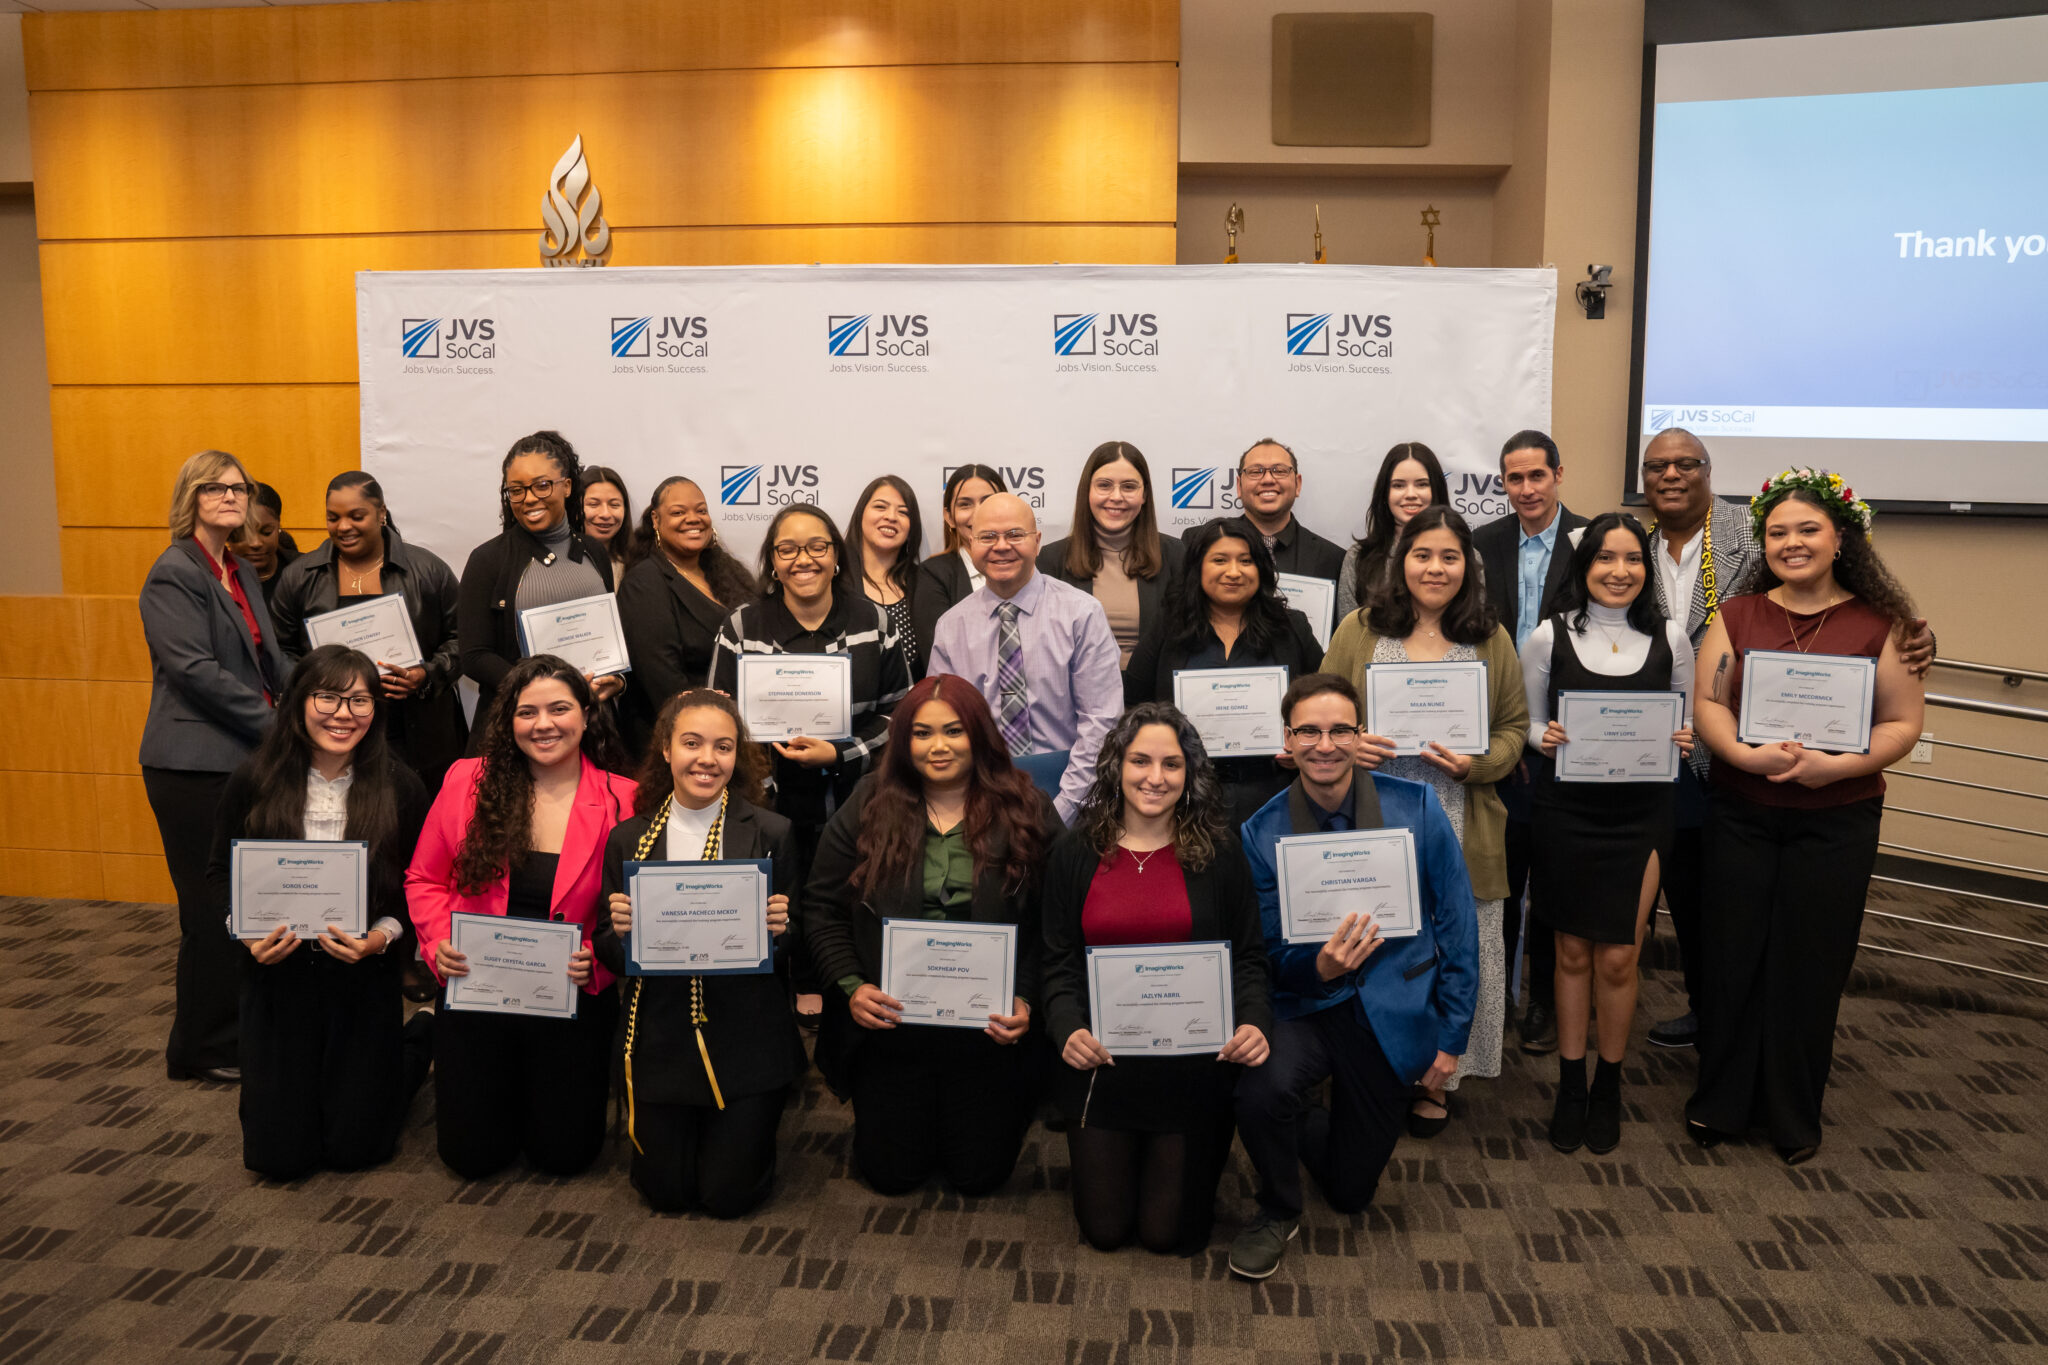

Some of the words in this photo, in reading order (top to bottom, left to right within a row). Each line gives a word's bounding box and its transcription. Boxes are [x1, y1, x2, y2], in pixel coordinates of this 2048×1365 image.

[1894, 228, 1997, 258] Thank
[2004, 234, 2048, 264] yo
[446, 319, 494, 340] JVS
[656, 317, 707, 338] JVS
[876, 315, 928, 337] JVS
[1103, 314, 1157, 336] JVS
[1336, 315, 1392, 338] JVS
[446, 343, 495, 358] SoCal
[657, 341, 707, 357] SoCal
[876, 340, 928, 356] SoCal
[1104, 339, 1158, 355] SoCal
[1337, 340, 1392, 357] SoCal
[1677, 410, 1708, 422] JVS
[1712, 410, 1755, 422] SoCal
[767, 465, 819, 486] JVS
[1455, 474, 1507, 495] JVS
[768, 490, 818, 505] SoCal
[1455, 498, 1509, 515] SoCal
